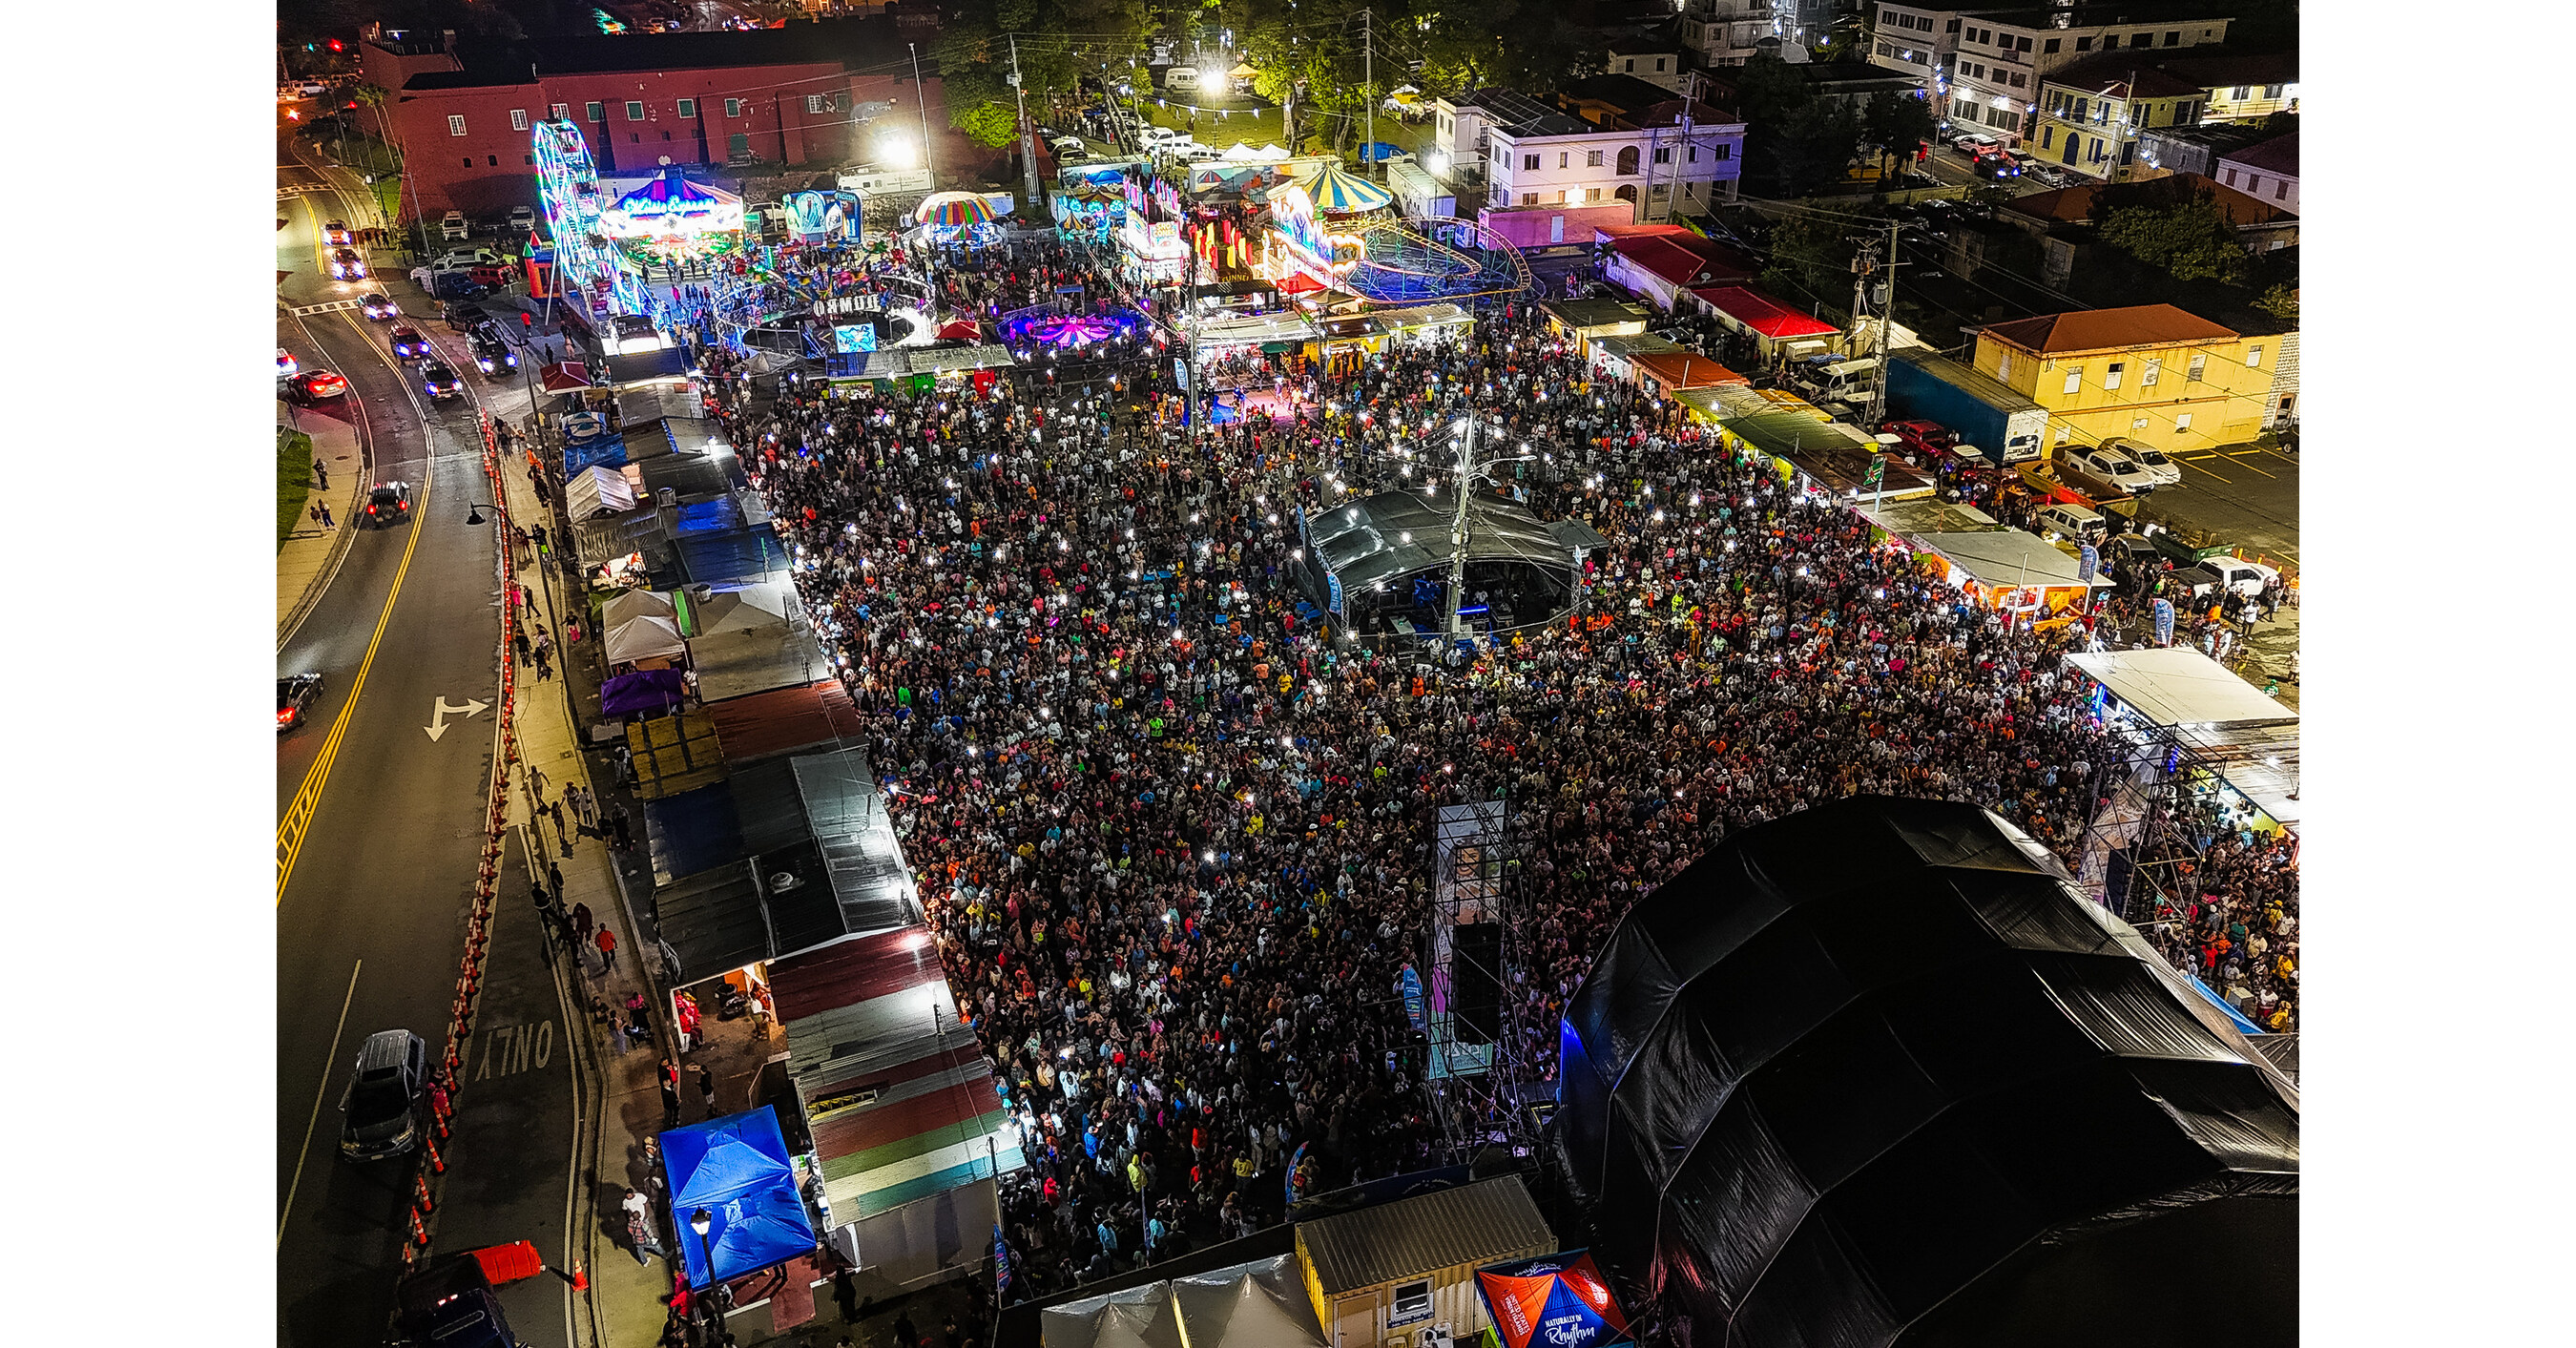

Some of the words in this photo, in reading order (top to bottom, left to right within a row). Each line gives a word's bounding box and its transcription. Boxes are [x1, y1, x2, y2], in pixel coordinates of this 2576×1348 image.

[1155, 221, 1173, 231] SNO
[475, 1020, 552, 1082] ONLY
[1505, 1296, 1517, 1317] VIRGIN
[1511, 1311, 1526, 1337] ISLANDS
[1509, 1293, 1523, 1317] UNITED
[1517, 1312, 1531, 1334] STATES
[1545, 1315, 1575, 1328] NATURALLY
[1574, 1314, 1583, 1322] IN
[1545, 1324, 1595, 1348] Rhythm
